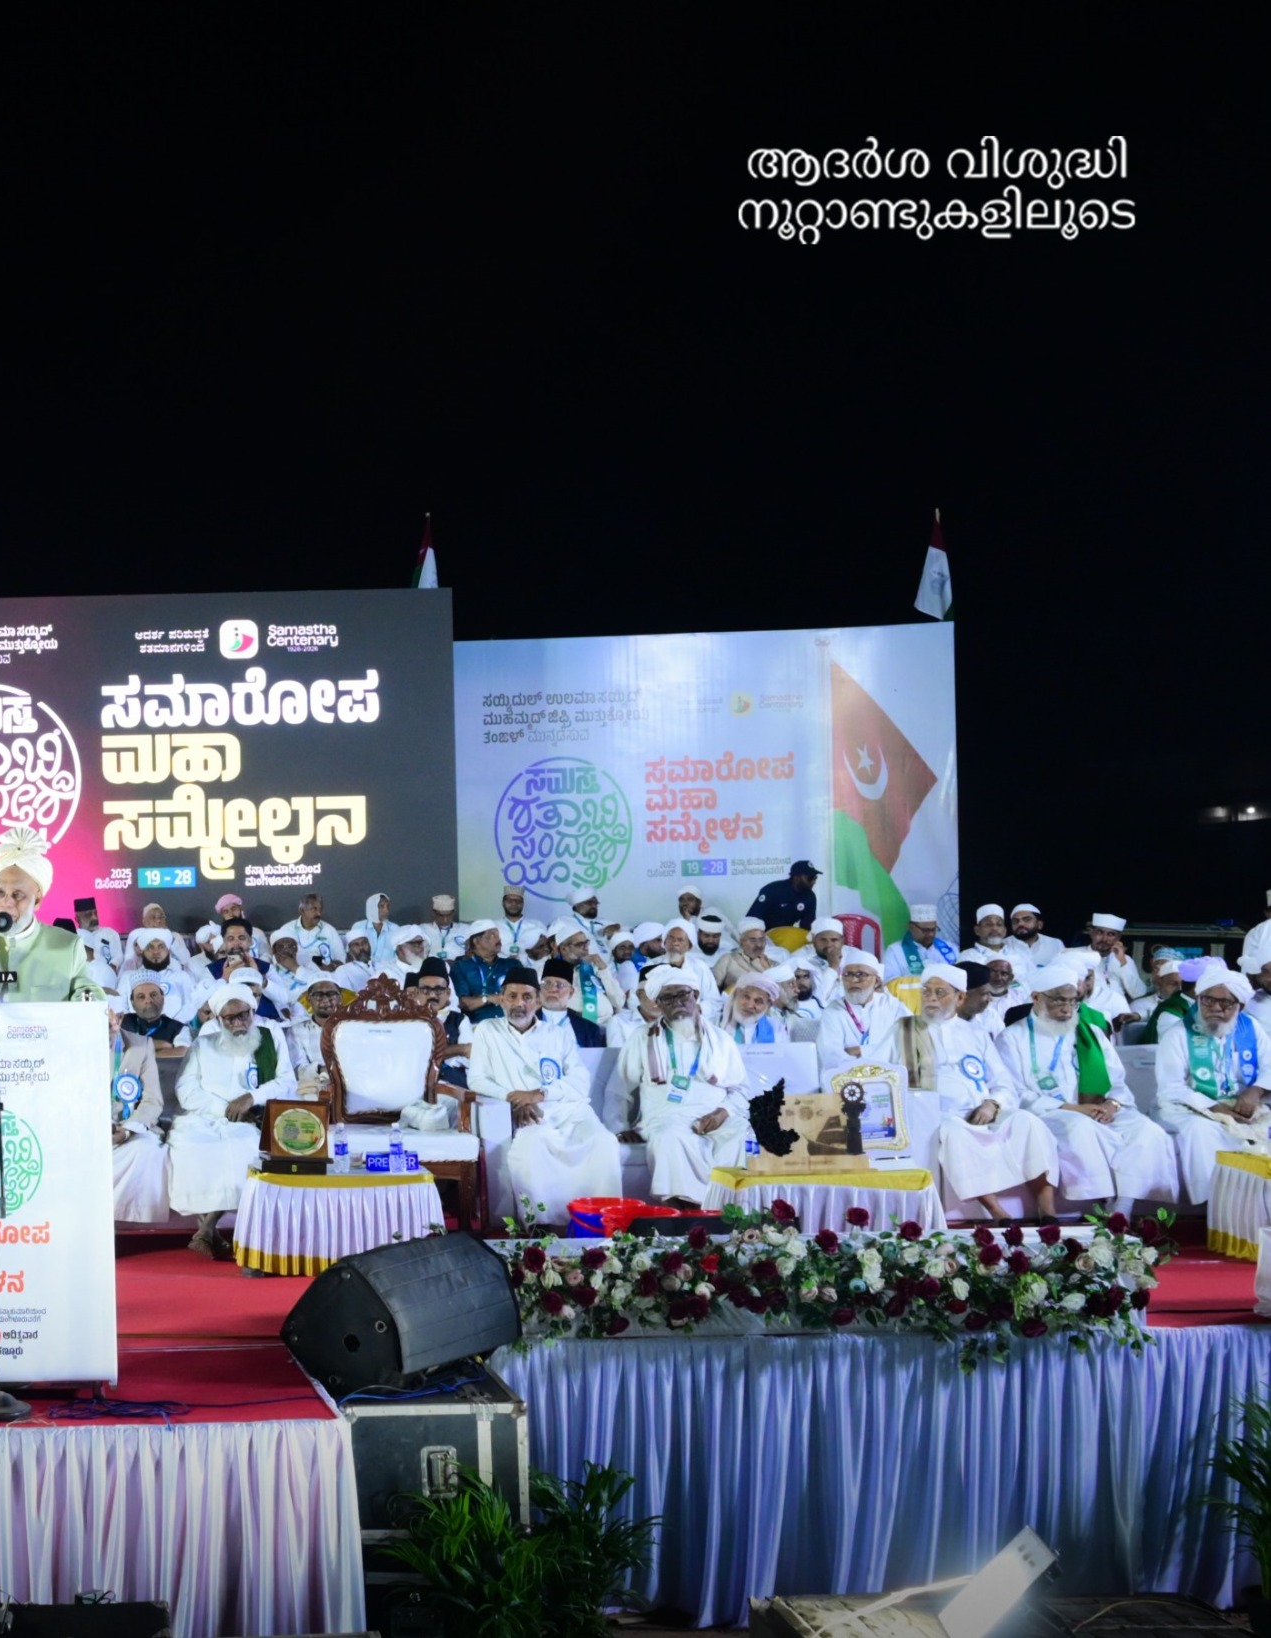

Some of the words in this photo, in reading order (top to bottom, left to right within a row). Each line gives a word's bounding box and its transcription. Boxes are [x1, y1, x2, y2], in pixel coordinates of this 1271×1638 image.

[268, 624, 336, 636] Samastha
[267, 634, 338, 647] Centenary
[101, 667, 380, 728] ಸಮಾರೋಪ
[102, 732, 241, 784] ಮಹಾ
[645, 751, 794, 783] ಸಮಾರೋಪ
[645, 784, 718, 811] ಮಹಾ
[103, 782, 366, 880] ಸಮ್ಮೇಳನ
[646, 811, 764, 854] ಸಮ್ಮೇಳನ
[659, 860, 676, 869] 2025
[687, 863, 699, 874] 19
[710, 861, 724, 873] 28
[110, 868, 132, 879] 2025
[145, 871, 161, 886] 19
[174, 870, 192, 885] 28
[368, 1157, 416, 1168] PRER
